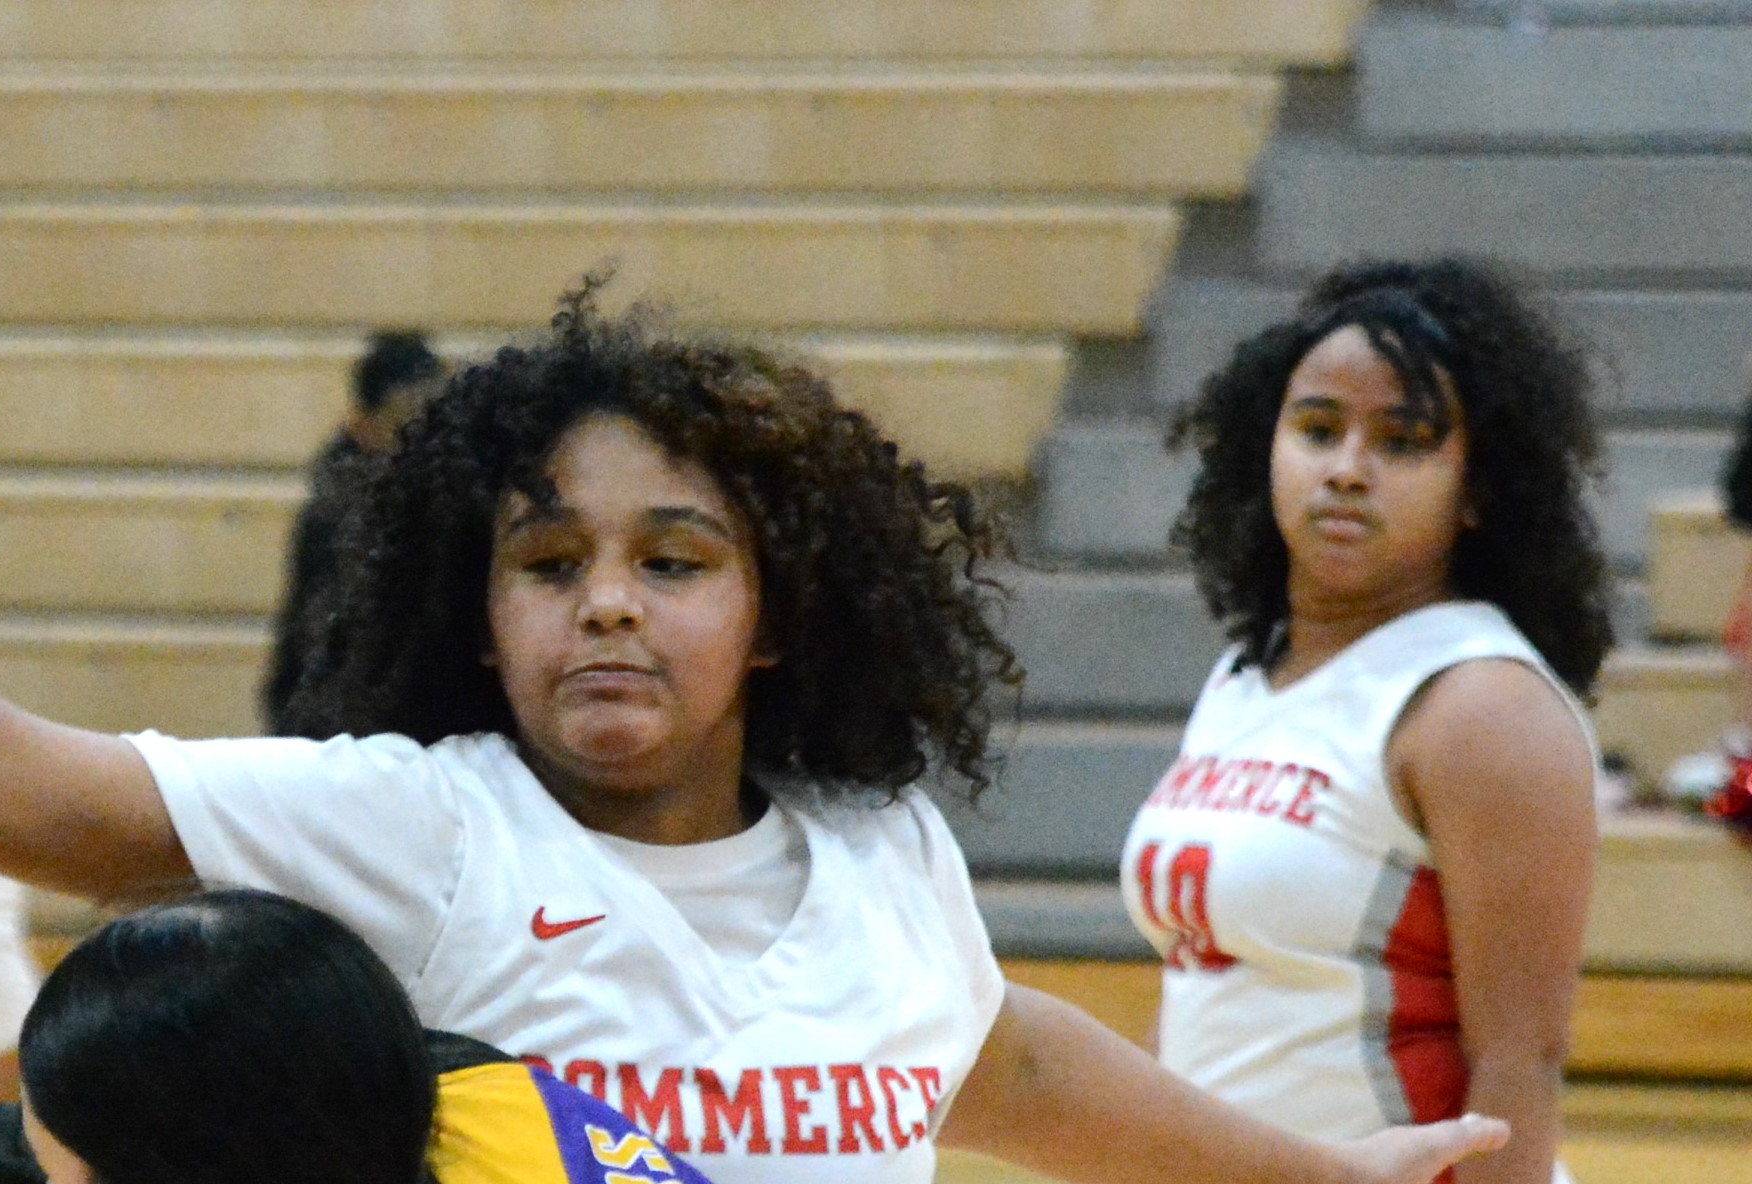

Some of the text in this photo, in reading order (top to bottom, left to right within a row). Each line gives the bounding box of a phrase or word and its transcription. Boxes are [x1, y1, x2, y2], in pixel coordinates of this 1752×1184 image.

[1148, 755, 1331, 828] MMERCE
[1135, 840, 1239, 972] 10
[519, 1056, 941, 1154] MMERCE
